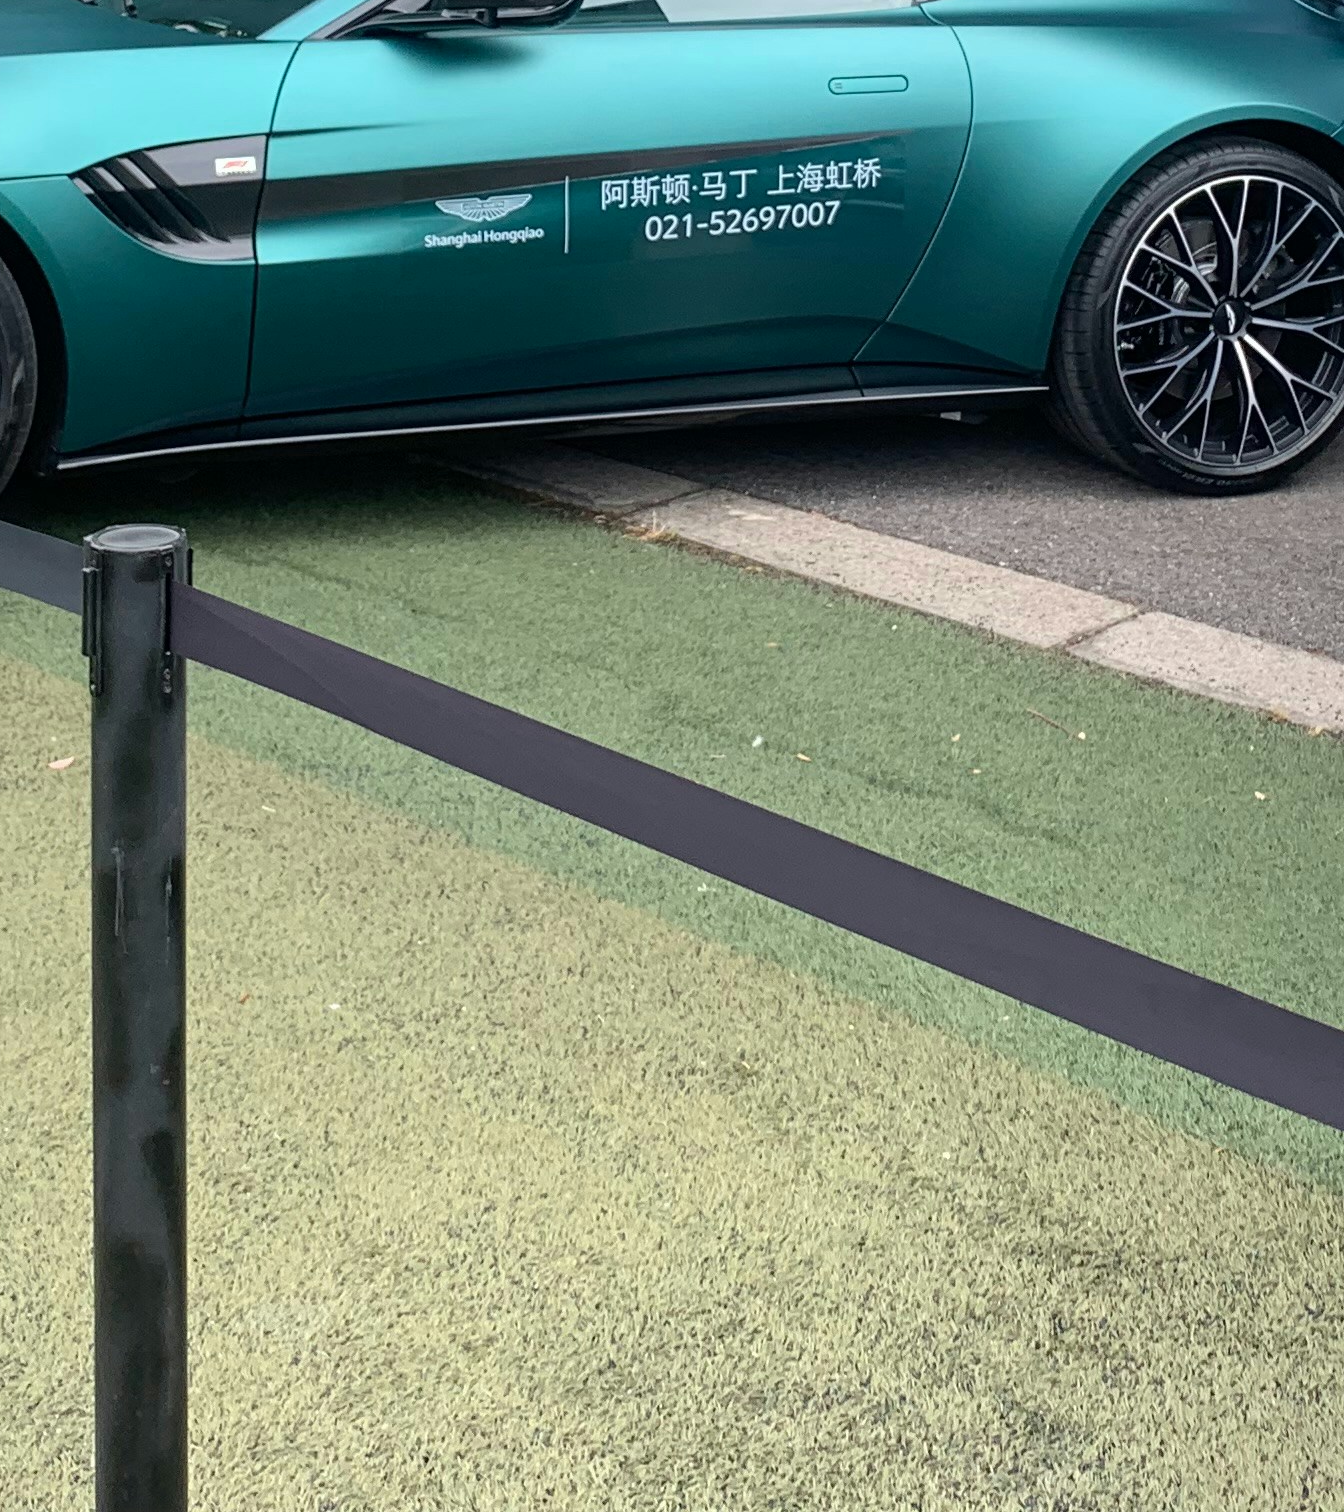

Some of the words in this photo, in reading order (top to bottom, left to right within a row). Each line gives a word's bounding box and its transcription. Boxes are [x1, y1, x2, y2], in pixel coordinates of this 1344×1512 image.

[601, 169, 757, 210] 阿斯顿·马丁
[767, 158, 882, 196] 上海虹桥
[424, 231, 482, 248] Shanghai
[484, 227, 544, 244] Hongqiao
[644, 200, 840, 241] 021-52697007
